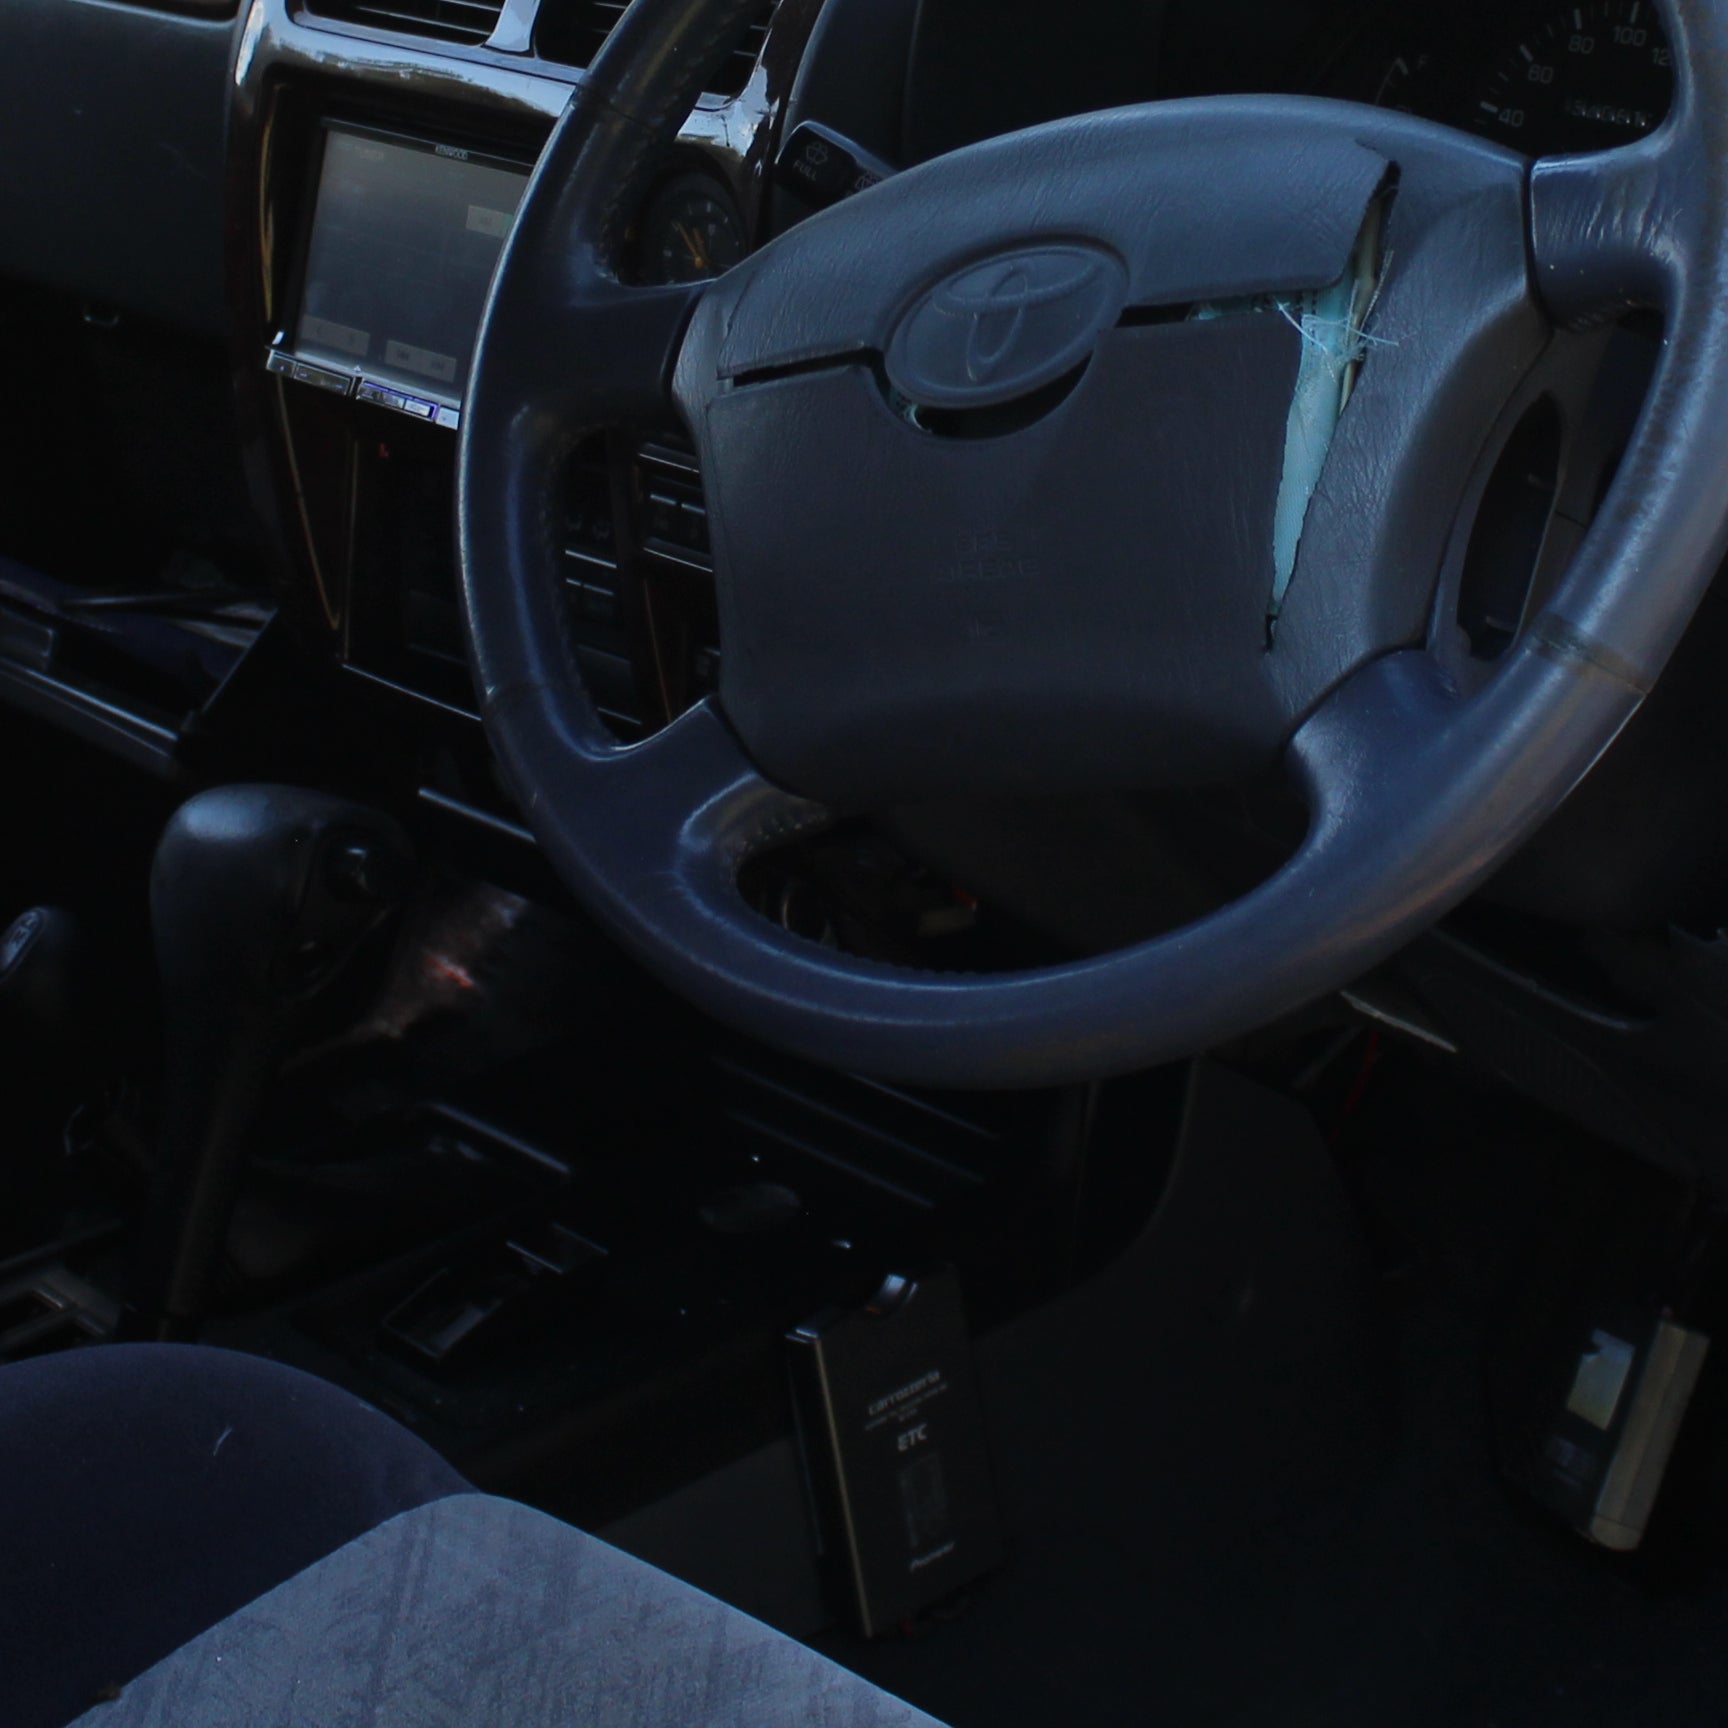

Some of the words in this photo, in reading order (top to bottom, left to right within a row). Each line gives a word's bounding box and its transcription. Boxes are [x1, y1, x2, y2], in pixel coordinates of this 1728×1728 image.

[1568, 34, 1594, 55] 80
[1613, 24, 1647, 47] 100
[1527, 63, 1554, 84] 60
[1497, 108, 1525, 128] 40
[793, 158, 817, 181] FULL
[897, 1421, 928, 1452] ETC
